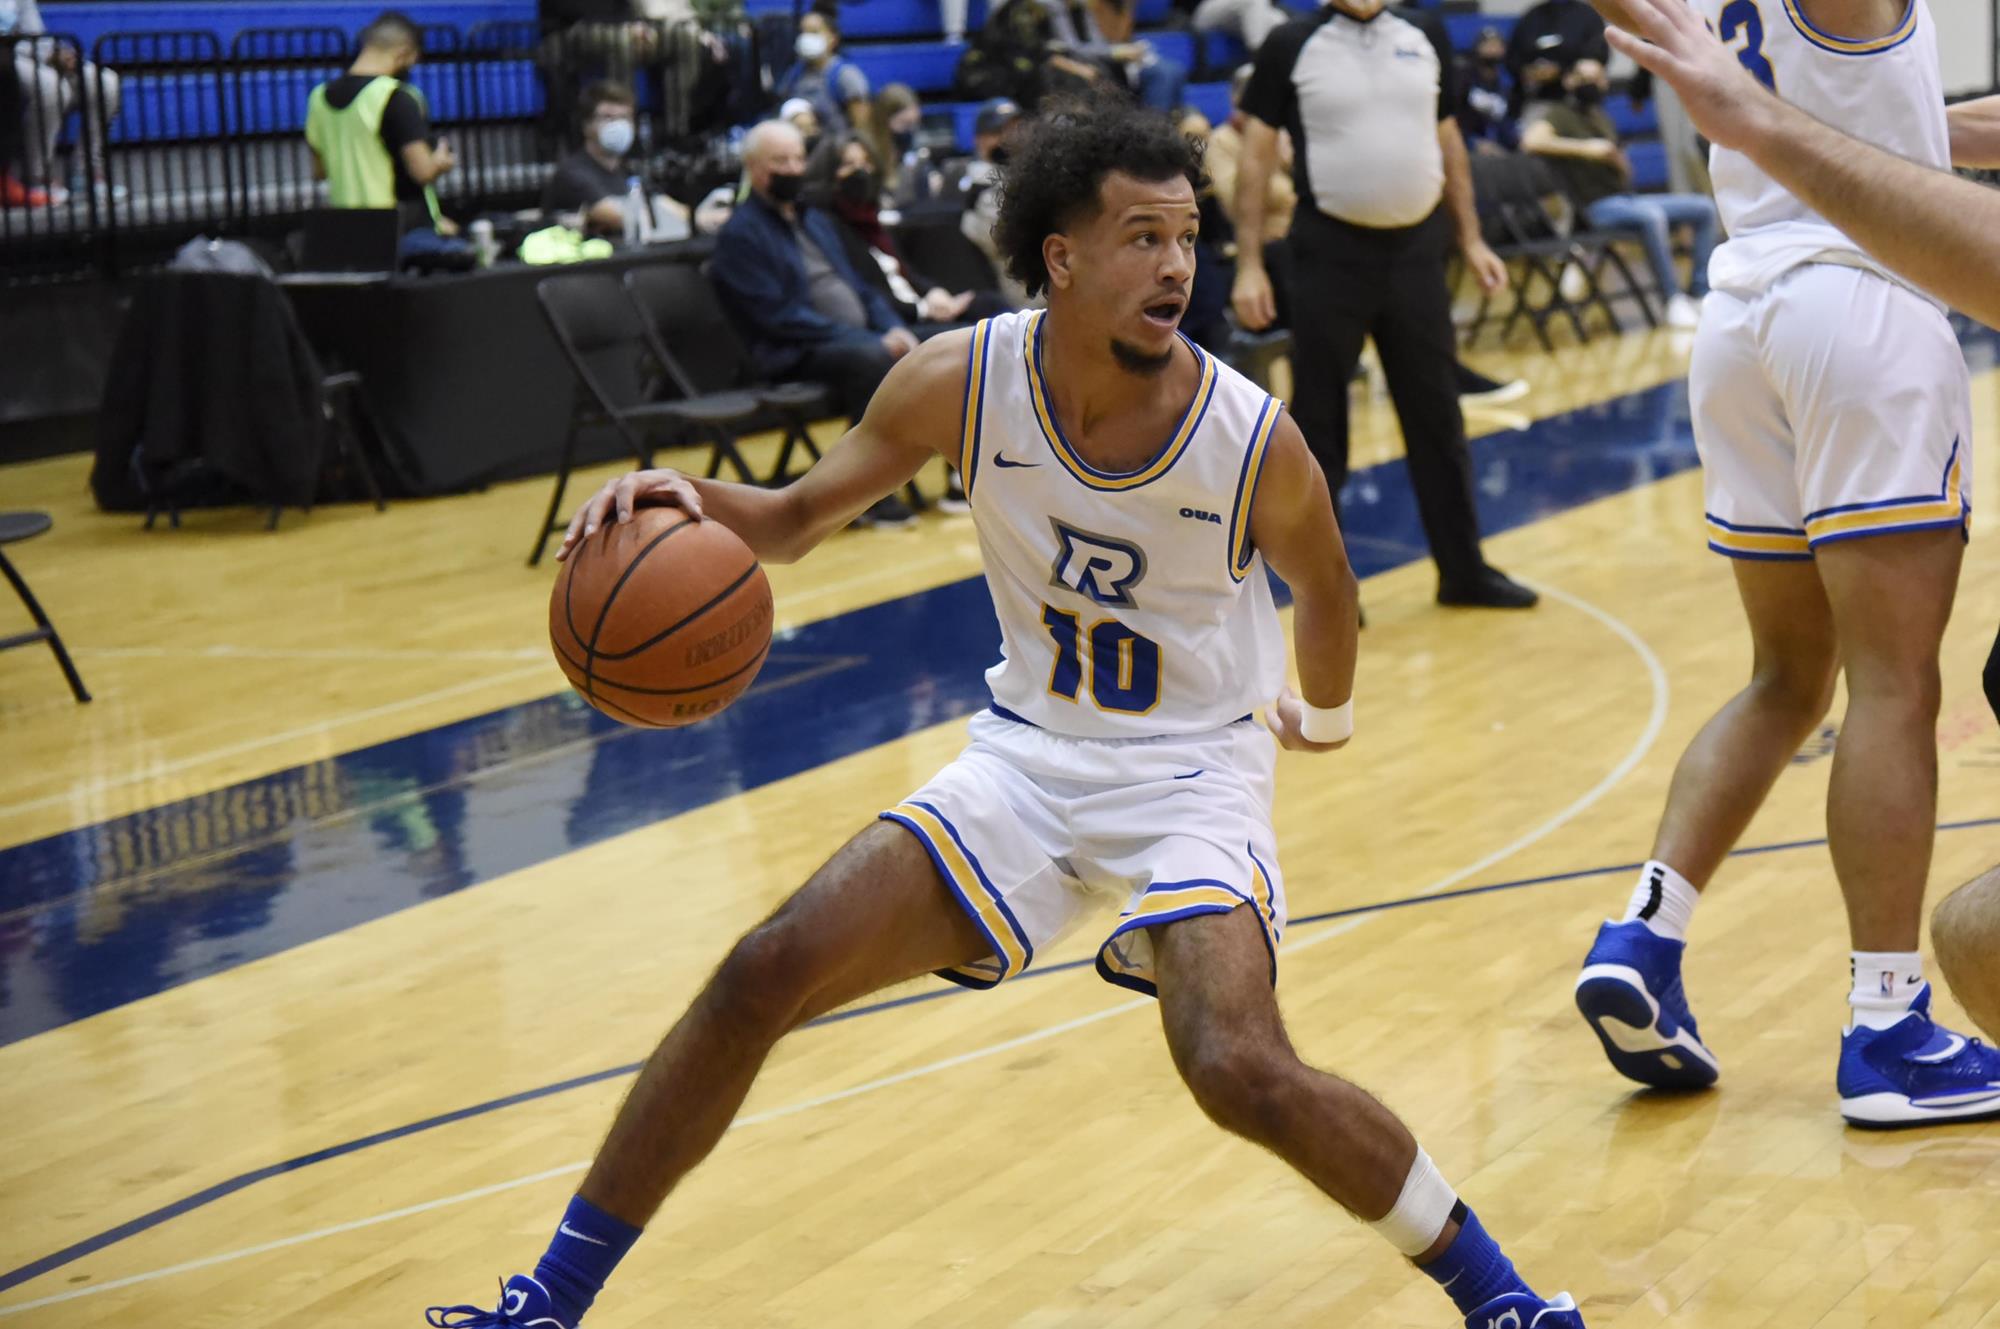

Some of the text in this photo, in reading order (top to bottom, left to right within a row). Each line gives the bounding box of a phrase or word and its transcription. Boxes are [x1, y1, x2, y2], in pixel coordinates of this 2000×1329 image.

[1703, 0, 1778, 96] 3
[1048, 515, 1148, 610] R
[1179, 507, 1222, 525] OUA
[1041, 601, 1163, 717] 10
